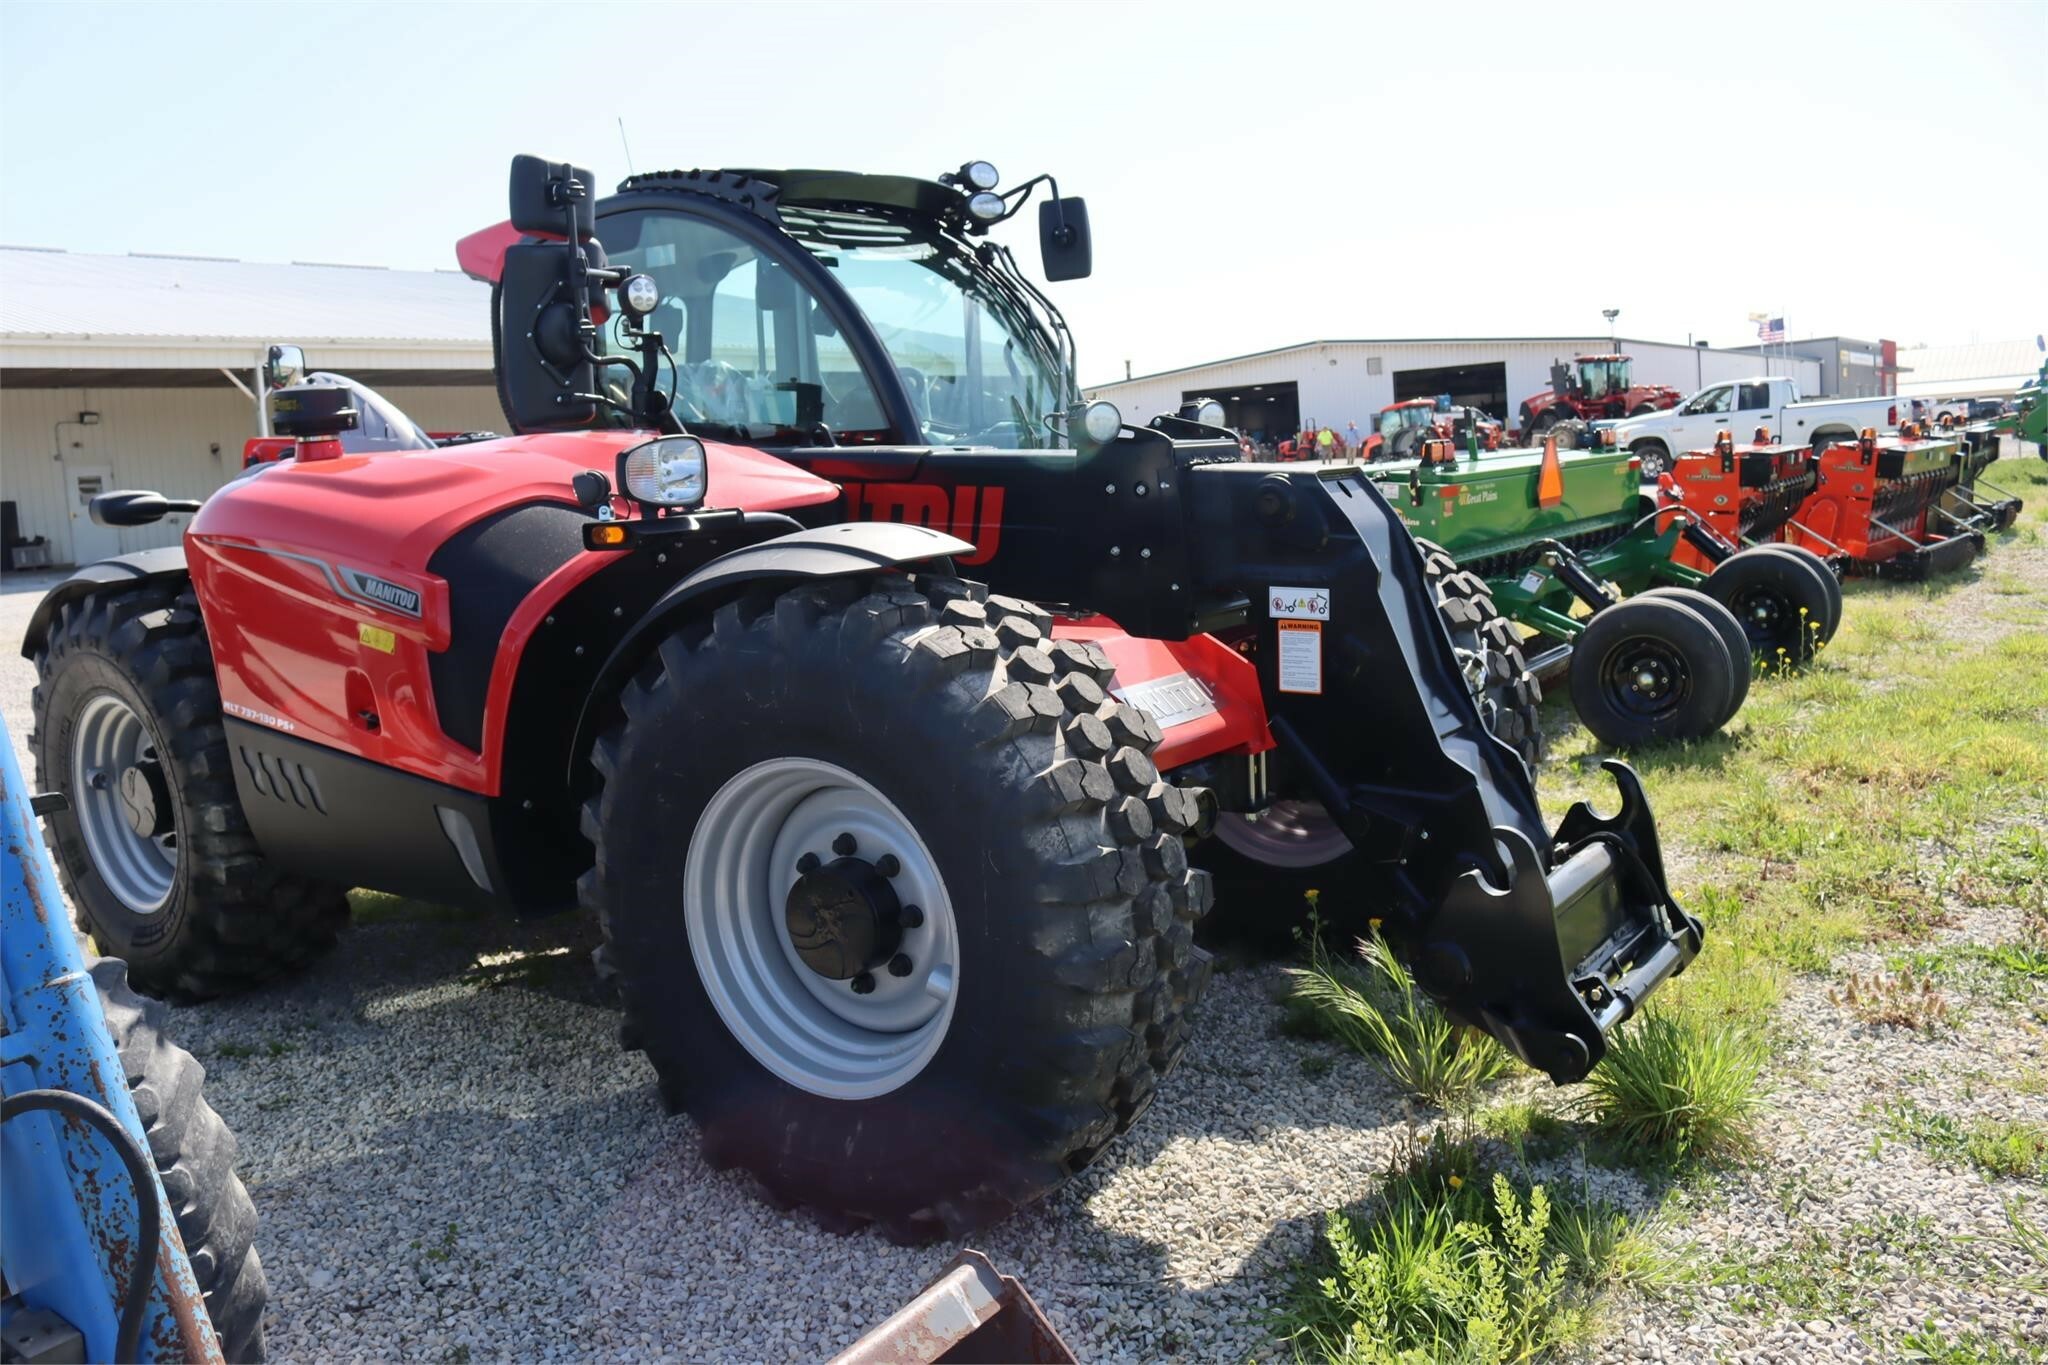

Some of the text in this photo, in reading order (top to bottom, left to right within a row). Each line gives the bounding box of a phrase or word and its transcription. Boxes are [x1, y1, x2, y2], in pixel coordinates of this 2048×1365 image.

[1467, 490, 1498, 505] Great Plains
[365, 579, 416, 609] MANITOU
